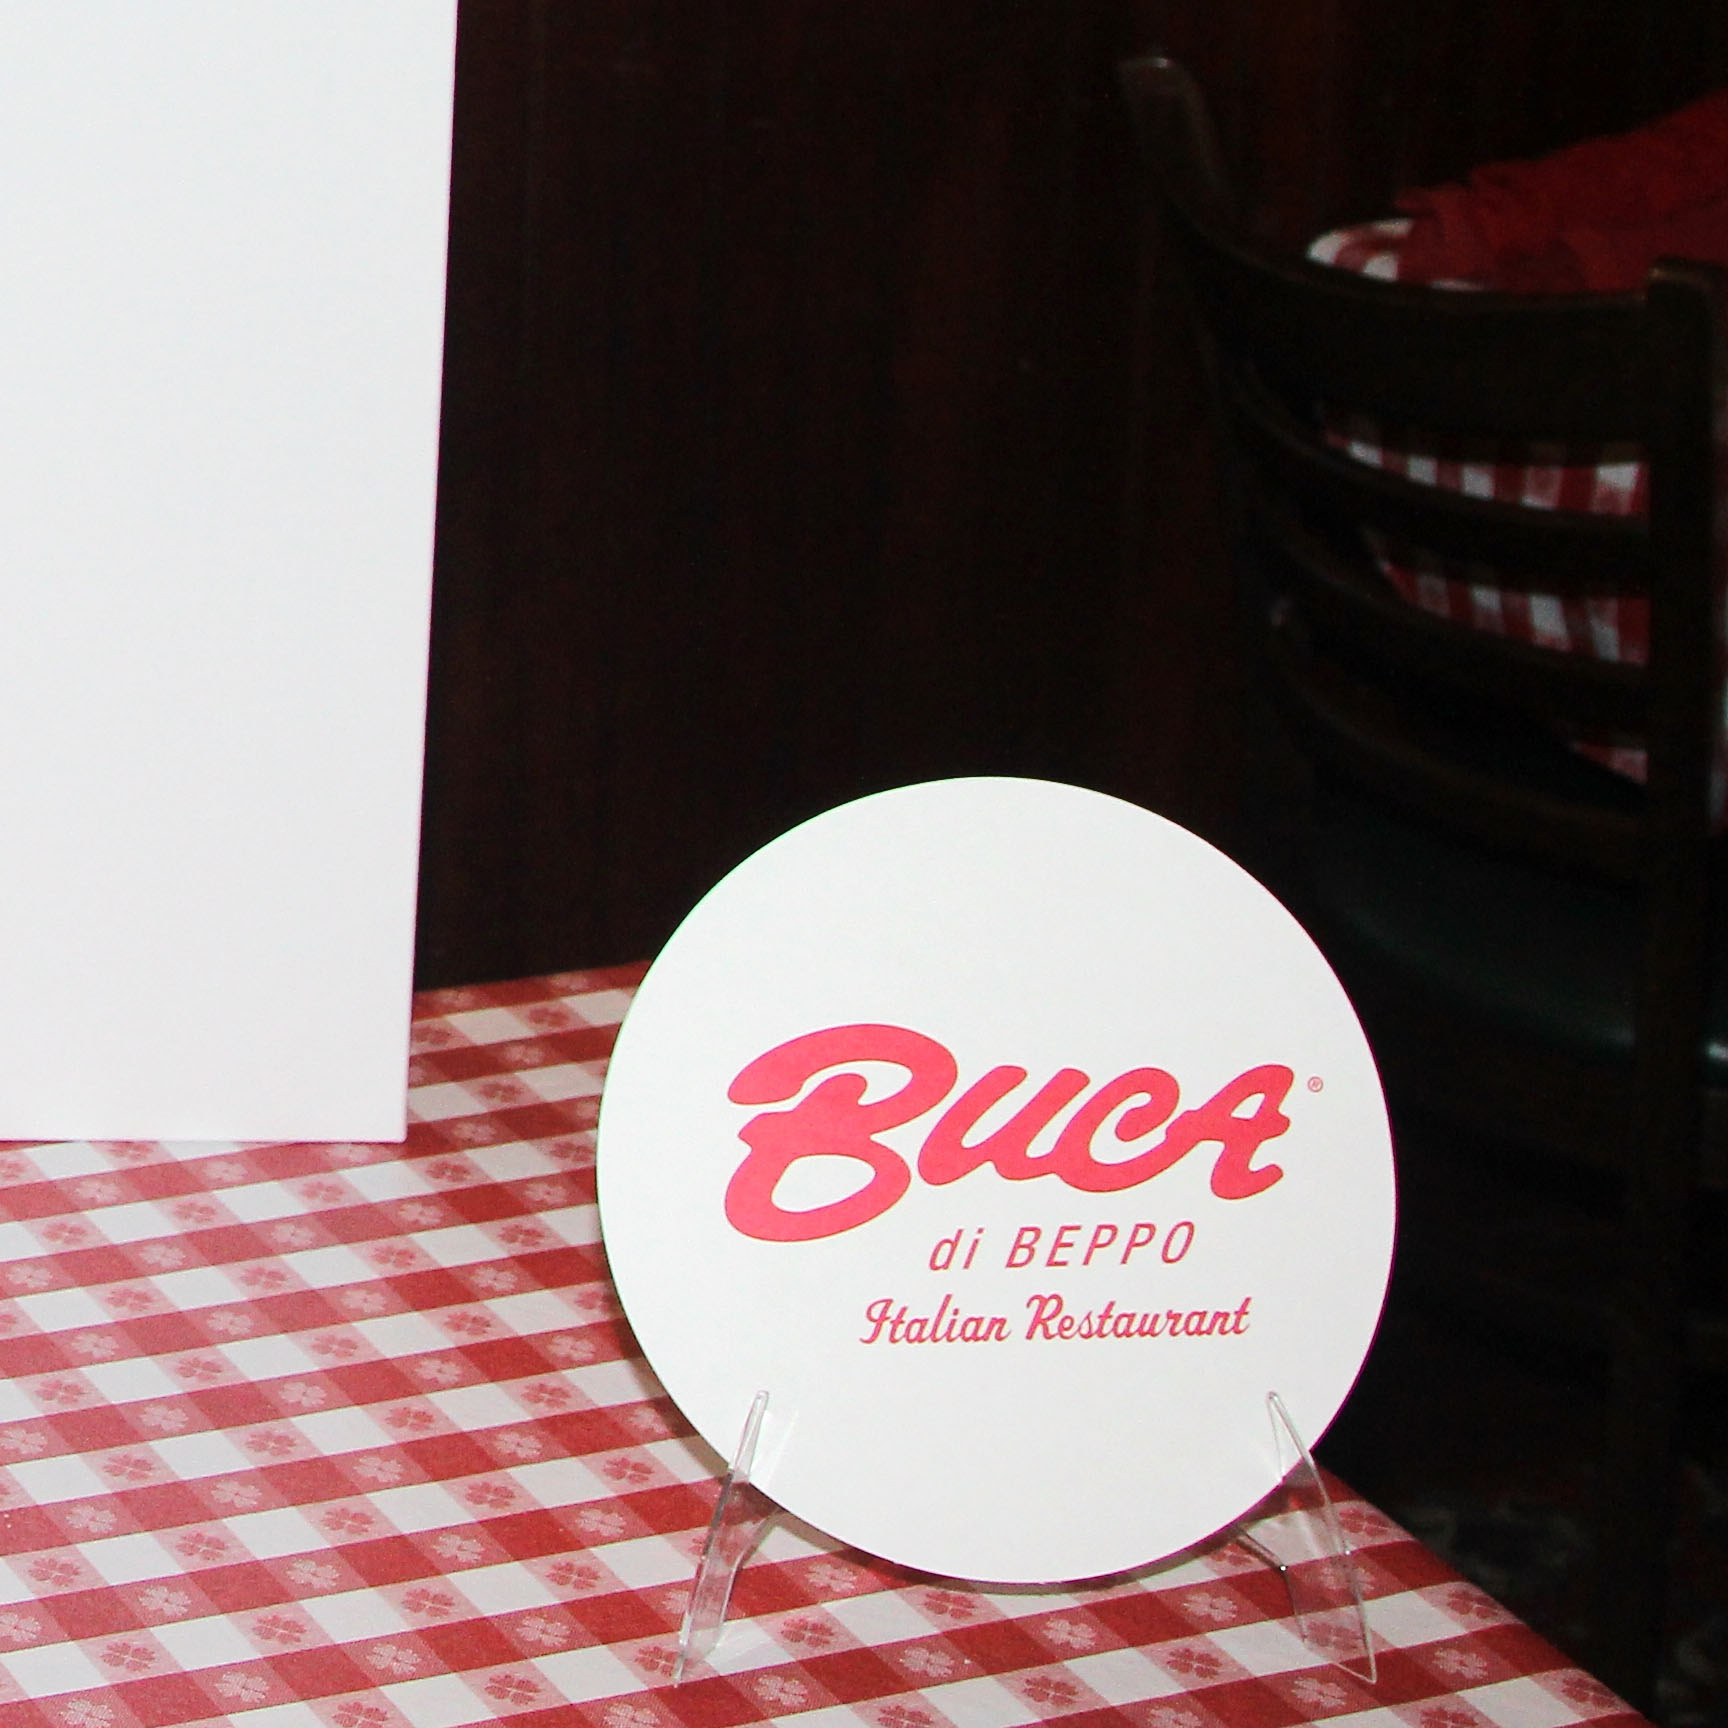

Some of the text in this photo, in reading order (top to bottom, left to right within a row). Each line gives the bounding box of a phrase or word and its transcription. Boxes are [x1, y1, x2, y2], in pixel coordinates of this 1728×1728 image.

[928, 1220, 1196, 1272] di BEPPO
[859, 1292, 1253, 1345] Italian Restaurant
